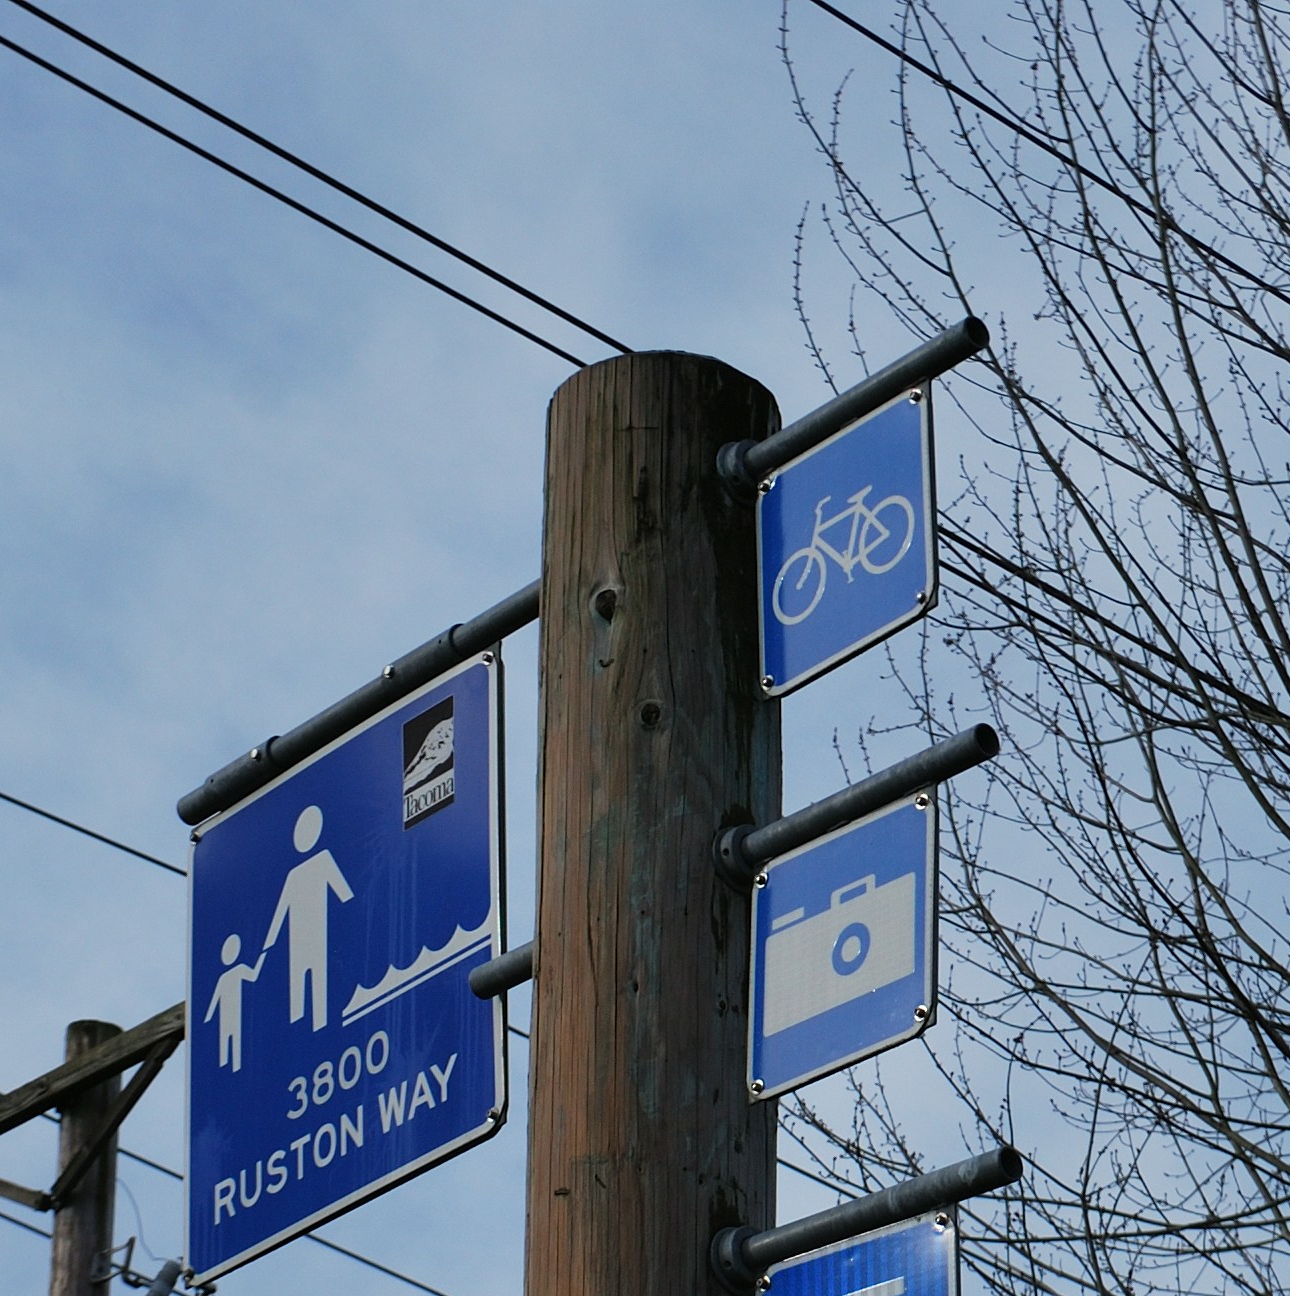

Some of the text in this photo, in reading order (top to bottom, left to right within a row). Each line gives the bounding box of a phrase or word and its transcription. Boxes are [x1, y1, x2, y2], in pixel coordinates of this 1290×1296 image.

[404, 776, 454, 819] Tacoma
[287, 1030, 389, 1119] 3800
[214, 1053, 458, 1225] RUSTON WAY
